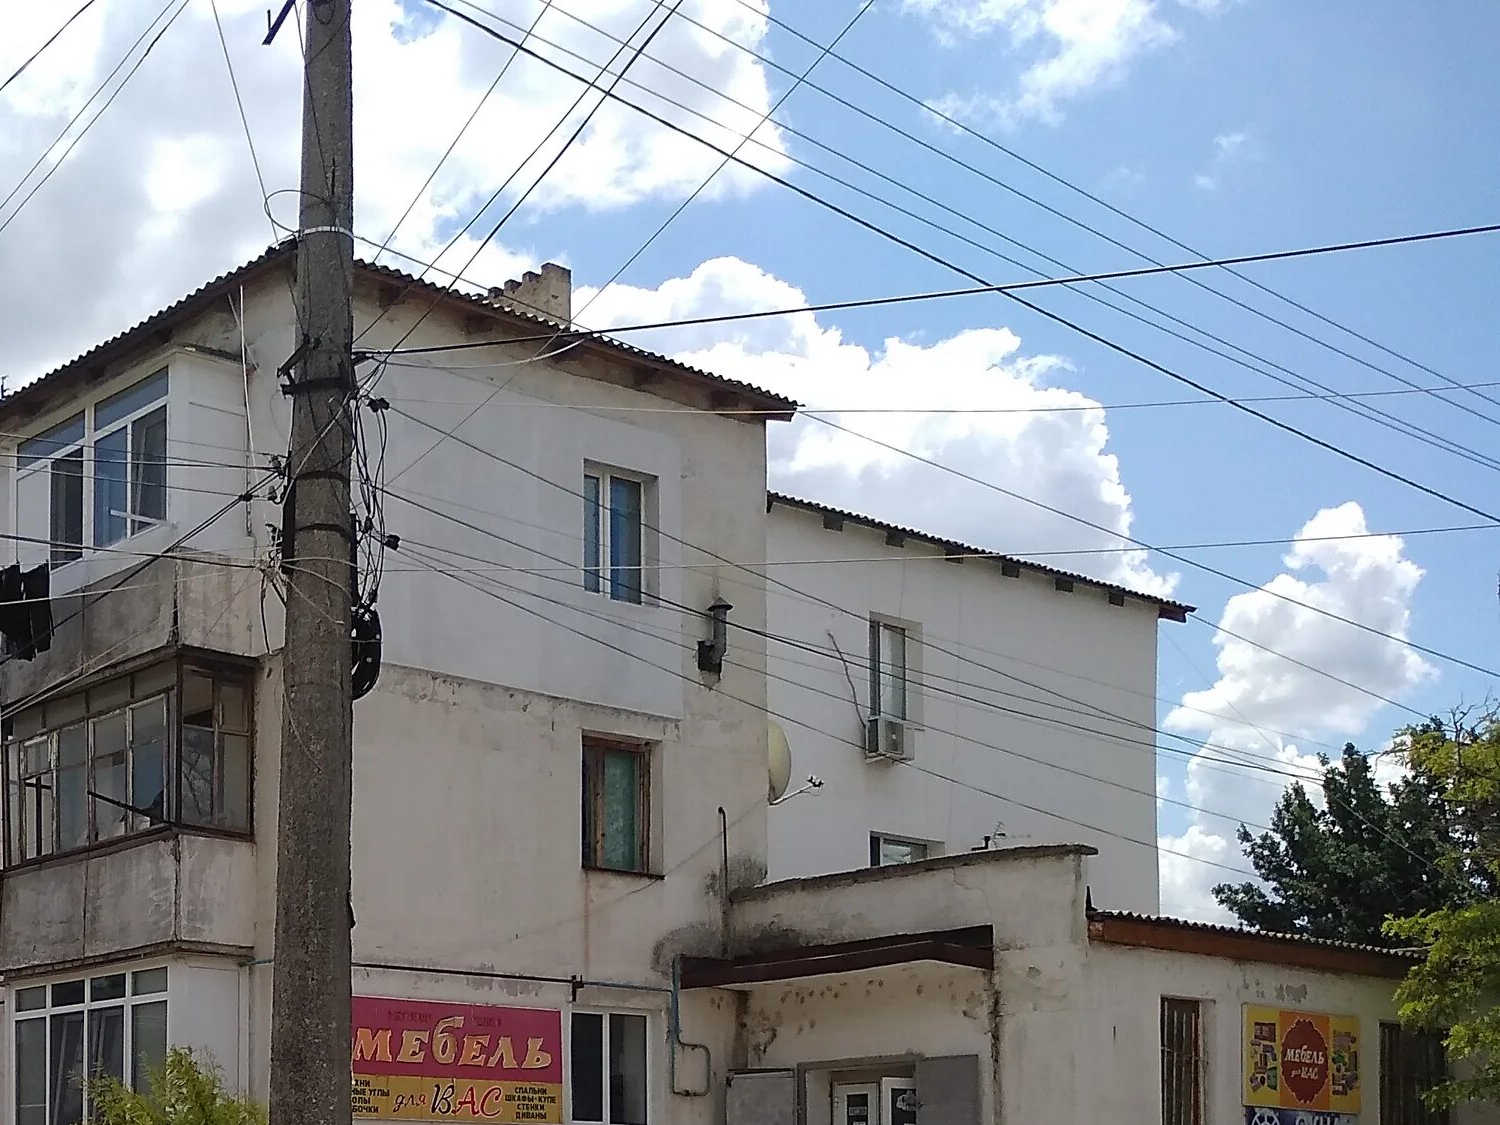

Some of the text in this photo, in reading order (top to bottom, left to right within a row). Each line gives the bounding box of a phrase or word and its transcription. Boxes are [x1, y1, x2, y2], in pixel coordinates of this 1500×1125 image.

[353, 1079, 371, 1088] ХНИ
[514, 1086, 548, 1096] СПАЛЬНИ
[352, 1096, 371, 1105] ОЛЫ
[392, 1093, 427, 1113] для
[504, 1094, 557, 1105] ШКАФЫ-КУПЕ
[352, 1105, 379, 1114] БОЧКИ
[516, 1103, 546, 1112] СТЕНКИ
[515, 1111, 547, 1120] ДИВАНЫ
